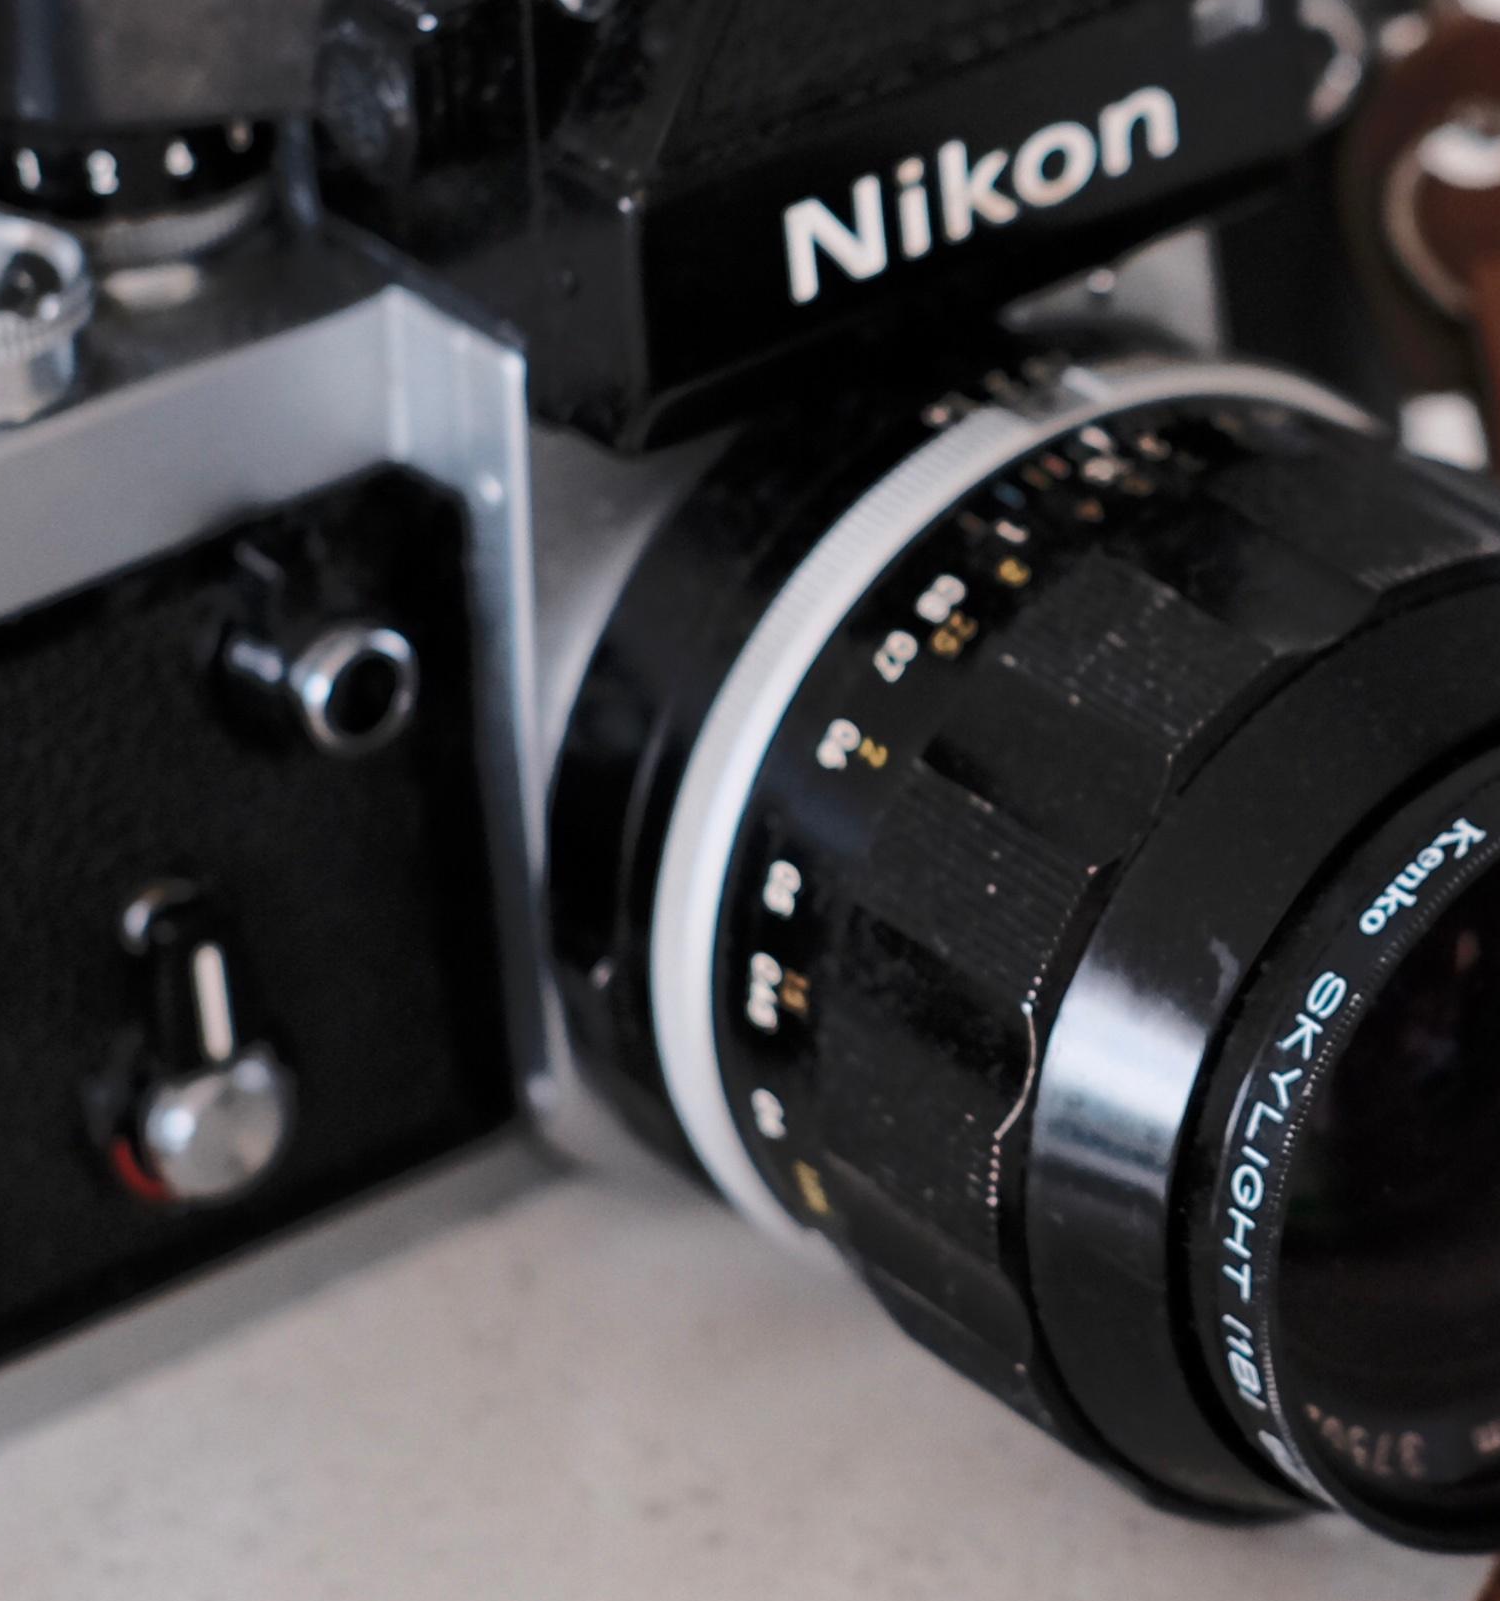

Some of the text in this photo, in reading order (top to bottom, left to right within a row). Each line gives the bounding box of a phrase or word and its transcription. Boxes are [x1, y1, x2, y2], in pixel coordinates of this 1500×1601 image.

[782, 84, 1180, 306] Nikon
[1358, 816, 1488, 936] Kenko
[1222, 970, 1348, 1304] SKYLIGHT
